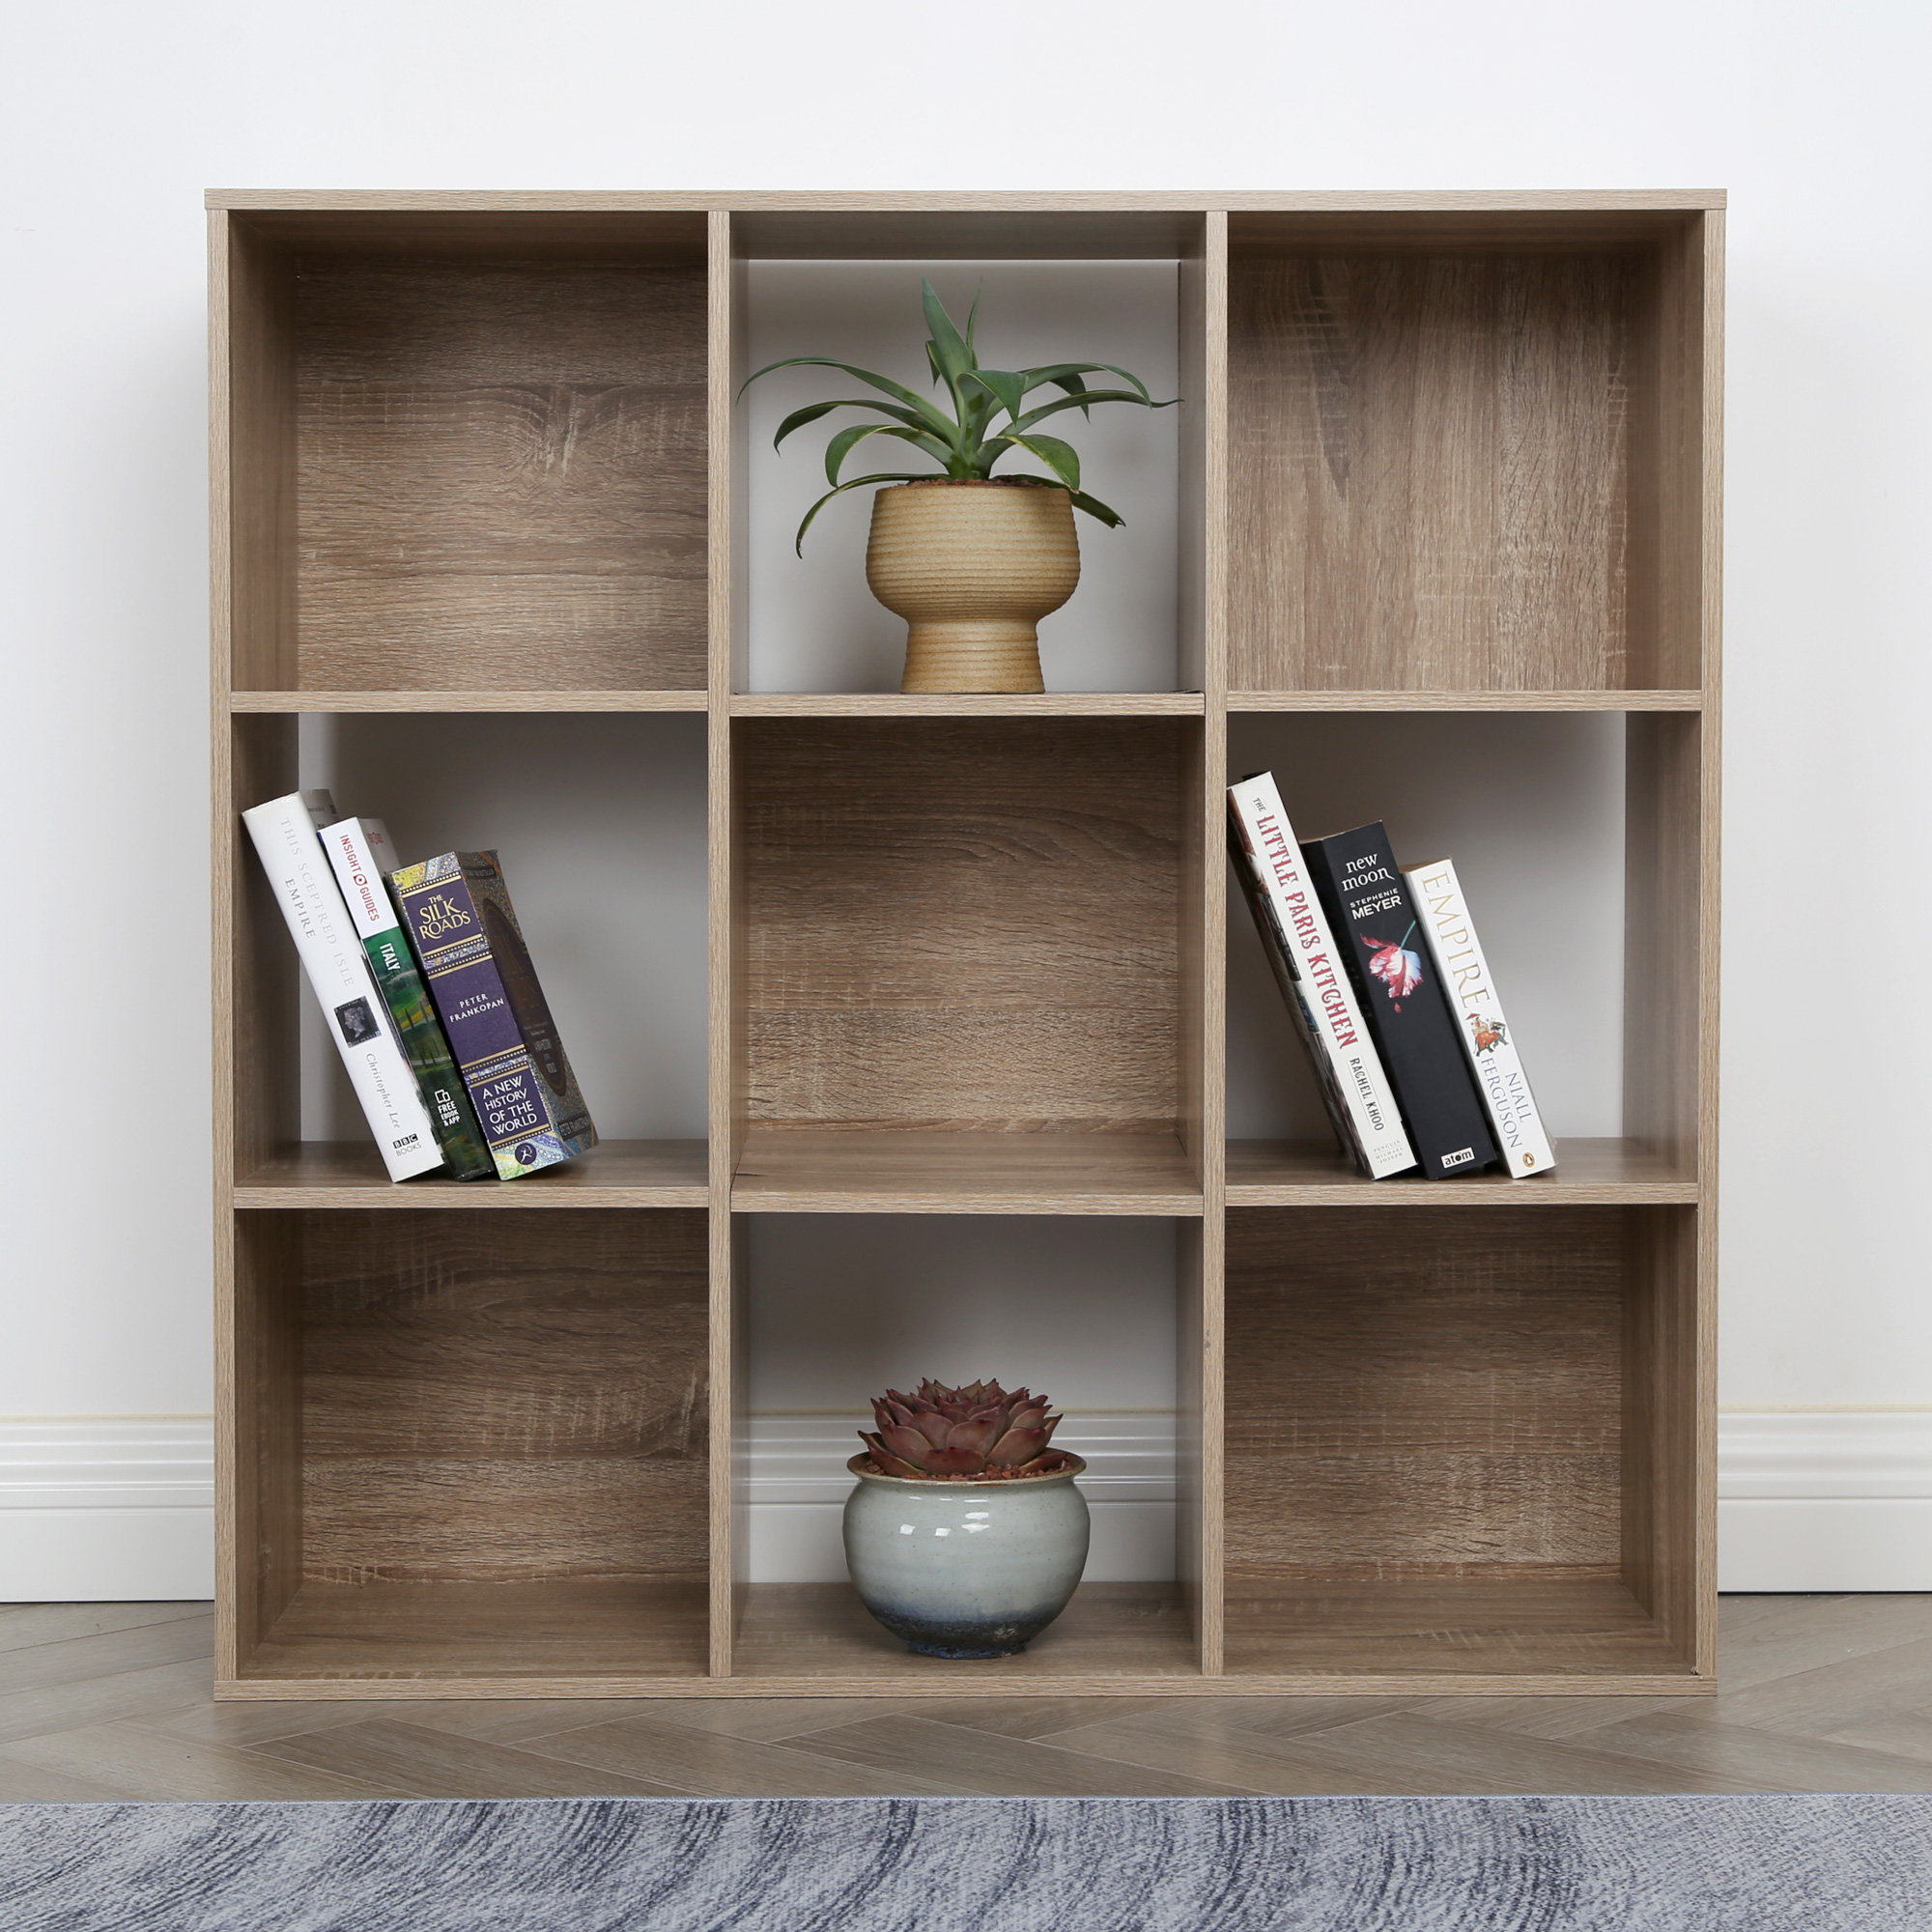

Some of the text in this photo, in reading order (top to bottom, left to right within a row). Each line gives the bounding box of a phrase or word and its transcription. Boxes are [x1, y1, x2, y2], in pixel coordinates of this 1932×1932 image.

[1253, 797, 1266, 812] THE
[1345, 853, 1378, 874] new
[339, 834, 380, 922] INSIGHT GUIDES
[1341, 867, 1396, 892] moon
[280, 817, 301, 855] THIS
[298, 863, 337, 946] SCEPTRED
[333, 952, 355, 986] ISLE
[285, 878, 317, 939] EMPIRE
[427, 894, 444, 905] THE
[1350, 887, 1399, 909] STEPHENIE
[1351, 895, 1402, 921] MEYER
[419, 897, 461, 925] SILK
[419, 911, 471, 940] ROADS
[1256, 814, 1359, 1050] LITTLE PARIS KITCHEN
[1422, 870, 1491, 1009] EMPIRE
[379, 942, 401, 971] ITALY
[449, 998, 504, 1023] FRANKOPAN
[459, 993, 489, 1009] PETER
[365, 1053, 400, 1128] Christopher Lee
[482, 1075, 523, 1099] A NEW
[484, 1088, 527, 1111] HISTORY
[1350, 1058, 1384, 1131] RACHEL KHOO
[1505, 1072, 1532, 1122] NIALL
[438, 1101, 456, 1114] FREE
[489, 1100, 533, 1124] OF THE
[1481, 1057, 1523, 1149] FERGUSON
[449, 1115, 460, 1125] APP
[492, 1113, 538, 1135] WORLD
[392, 1133, 419, 1150] BBC
[395, 1143, 422, 1156] BOOKS
[1444, 1150, 1473, 1166] atom
